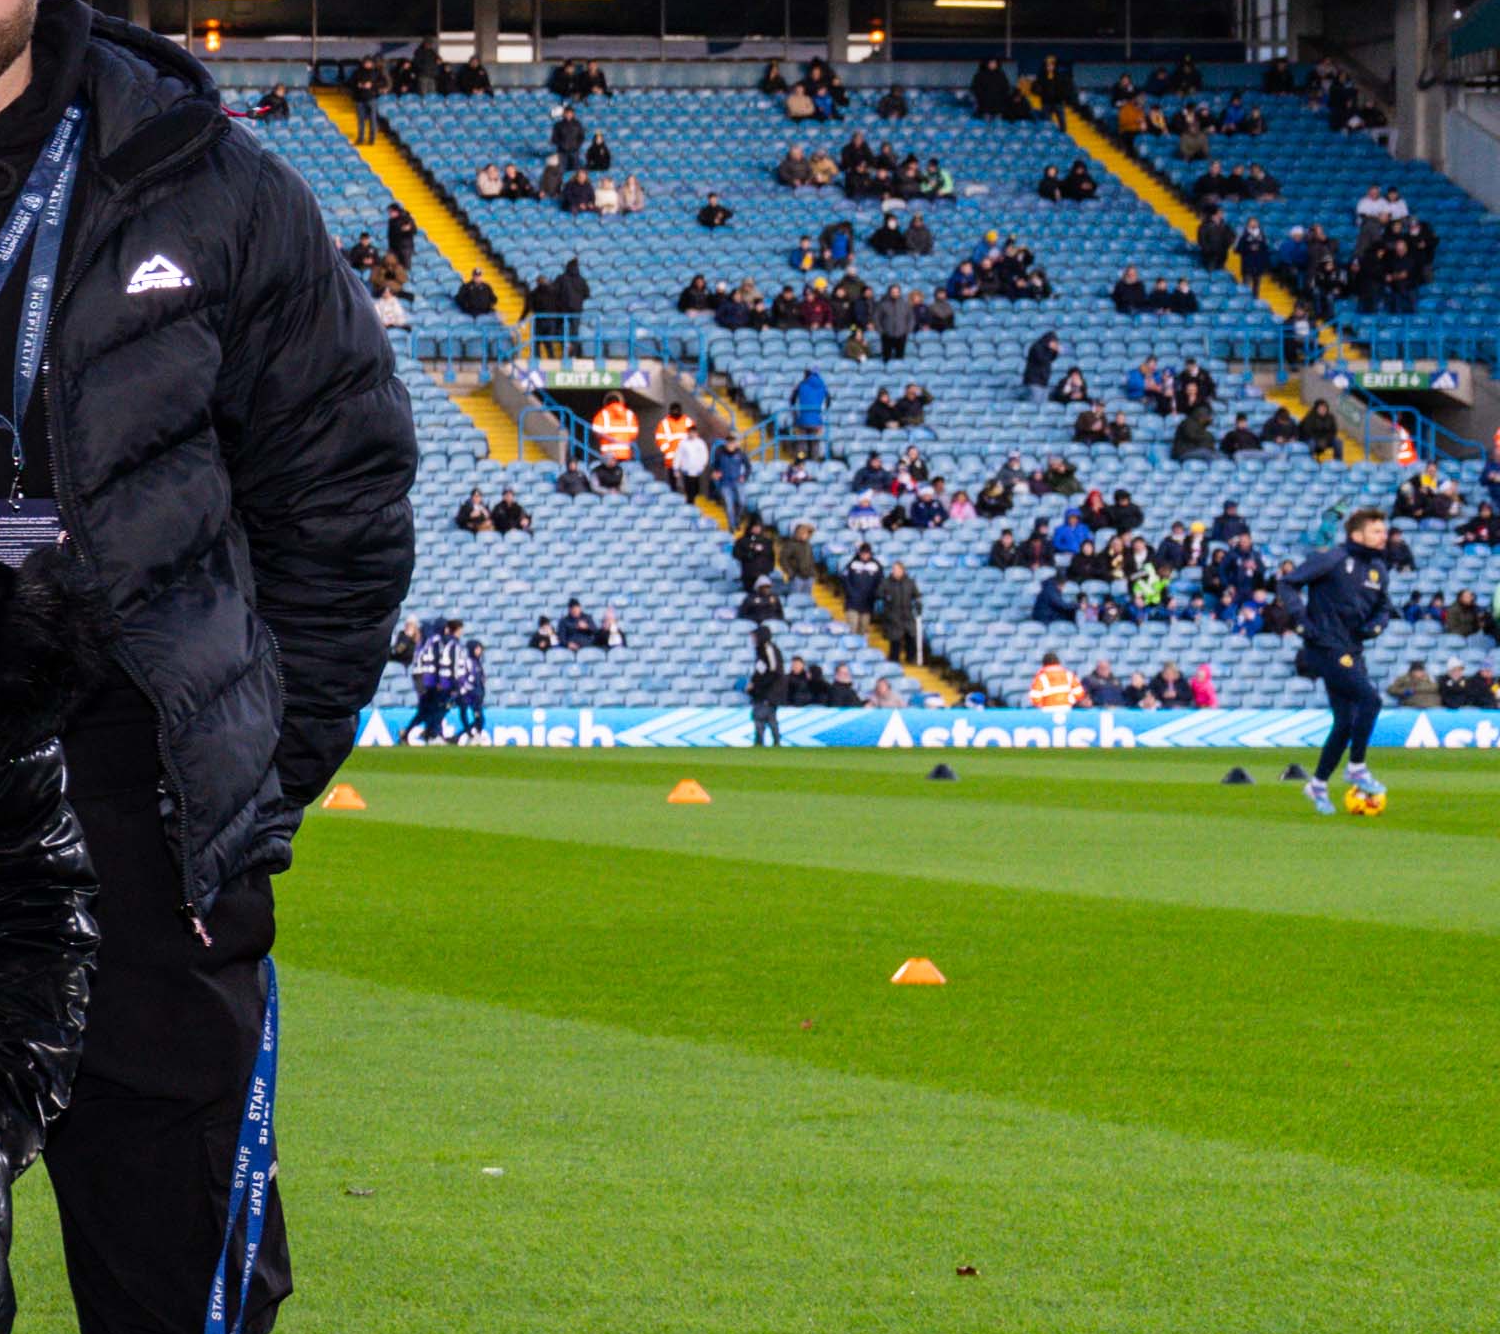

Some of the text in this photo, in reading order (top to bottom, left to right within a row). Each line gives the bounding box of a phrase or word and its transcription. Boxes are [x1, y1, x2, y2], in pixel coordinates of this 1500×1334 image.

[2, 212, 32, 261] LEEDS UNITED
[19, 293, 40, 379] HOSPITALITY
[556, 372, 589, 386] EXIT
[1363, 373, 1396, 387] EXIT
[249, 1076, 267, 1121] STAFF
[235, 1146, 251, 1189] STAFF
[251, 1171, 265, 1215] STAFF
[211, 1276, 224, 1321] STAFF
